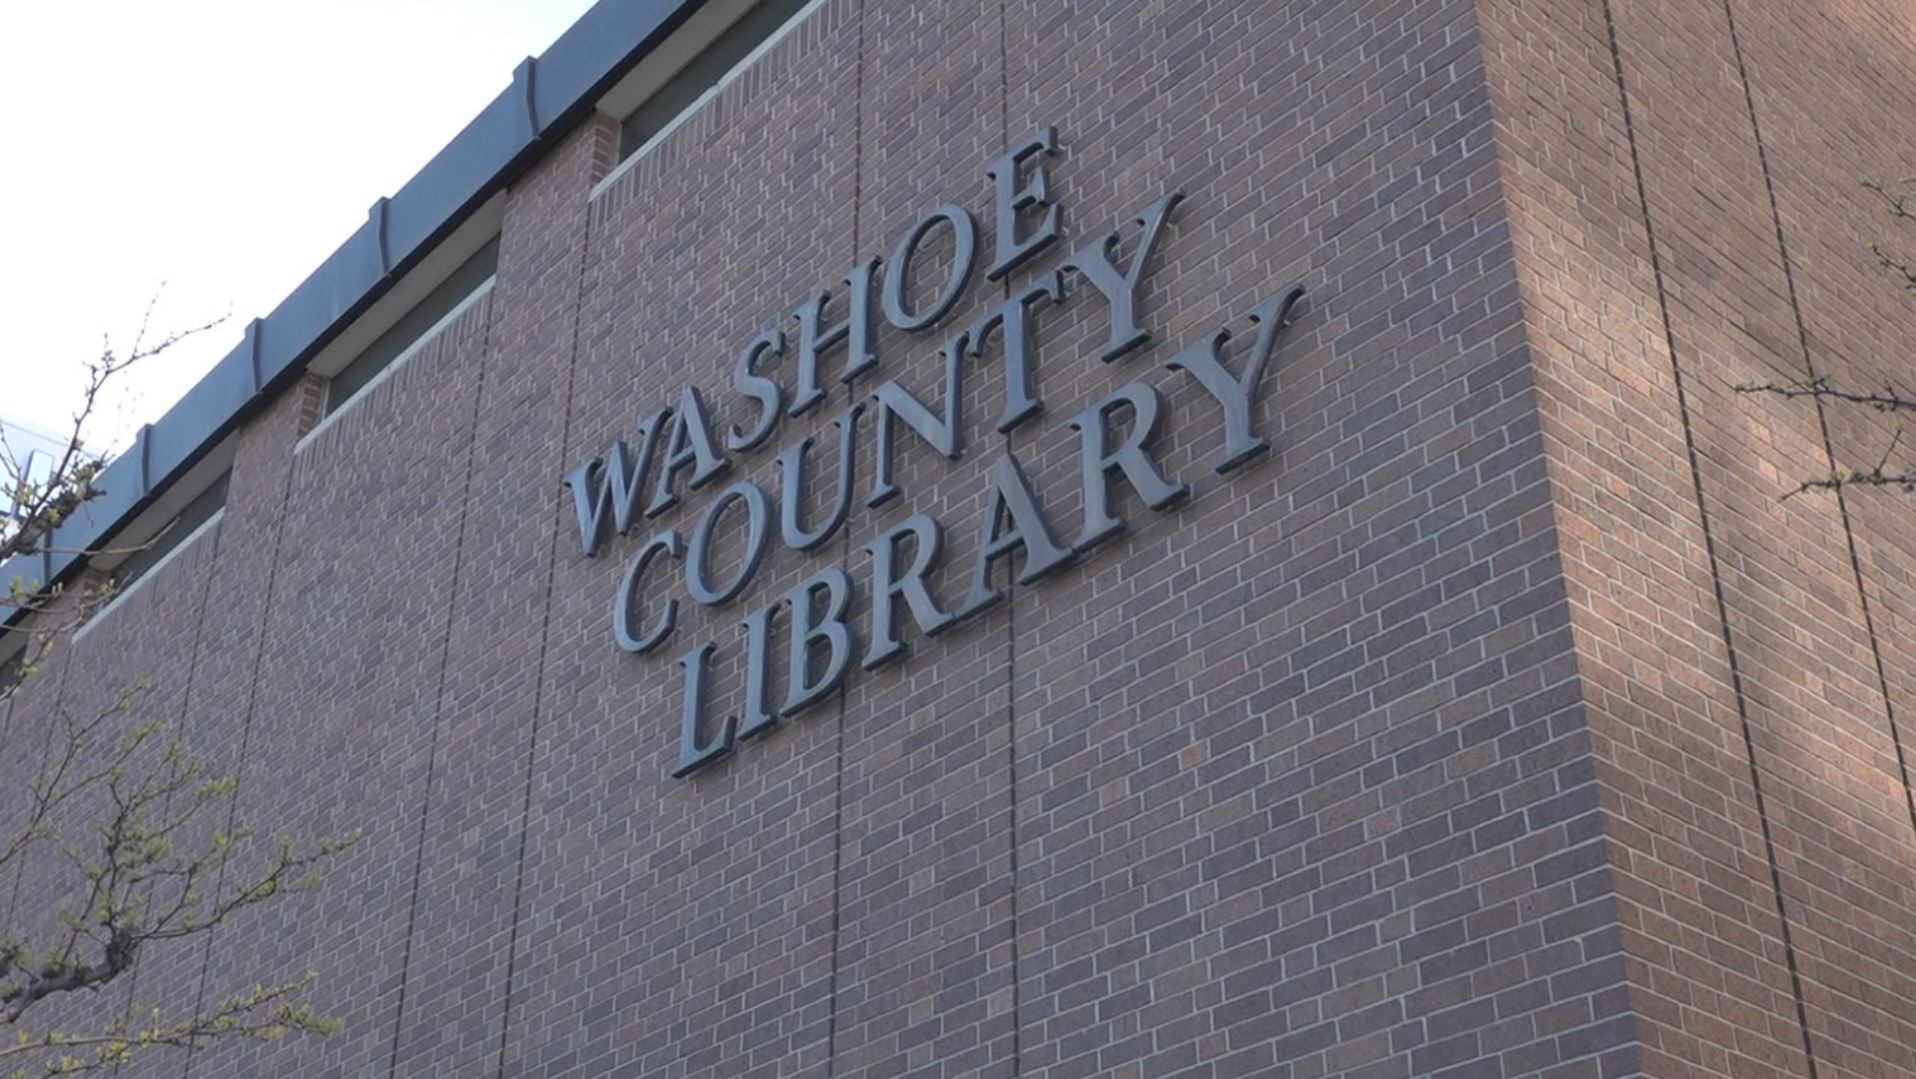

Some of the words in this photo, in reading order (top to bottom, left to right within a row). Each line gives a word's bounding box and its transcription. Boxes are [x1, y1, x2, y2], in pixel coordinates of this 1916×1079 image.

[563, 124, 1060, 557] WASHOE
[612, 188, 1186, 653] COUNTY
[674, 286, 1304, 777] LIBRARY
